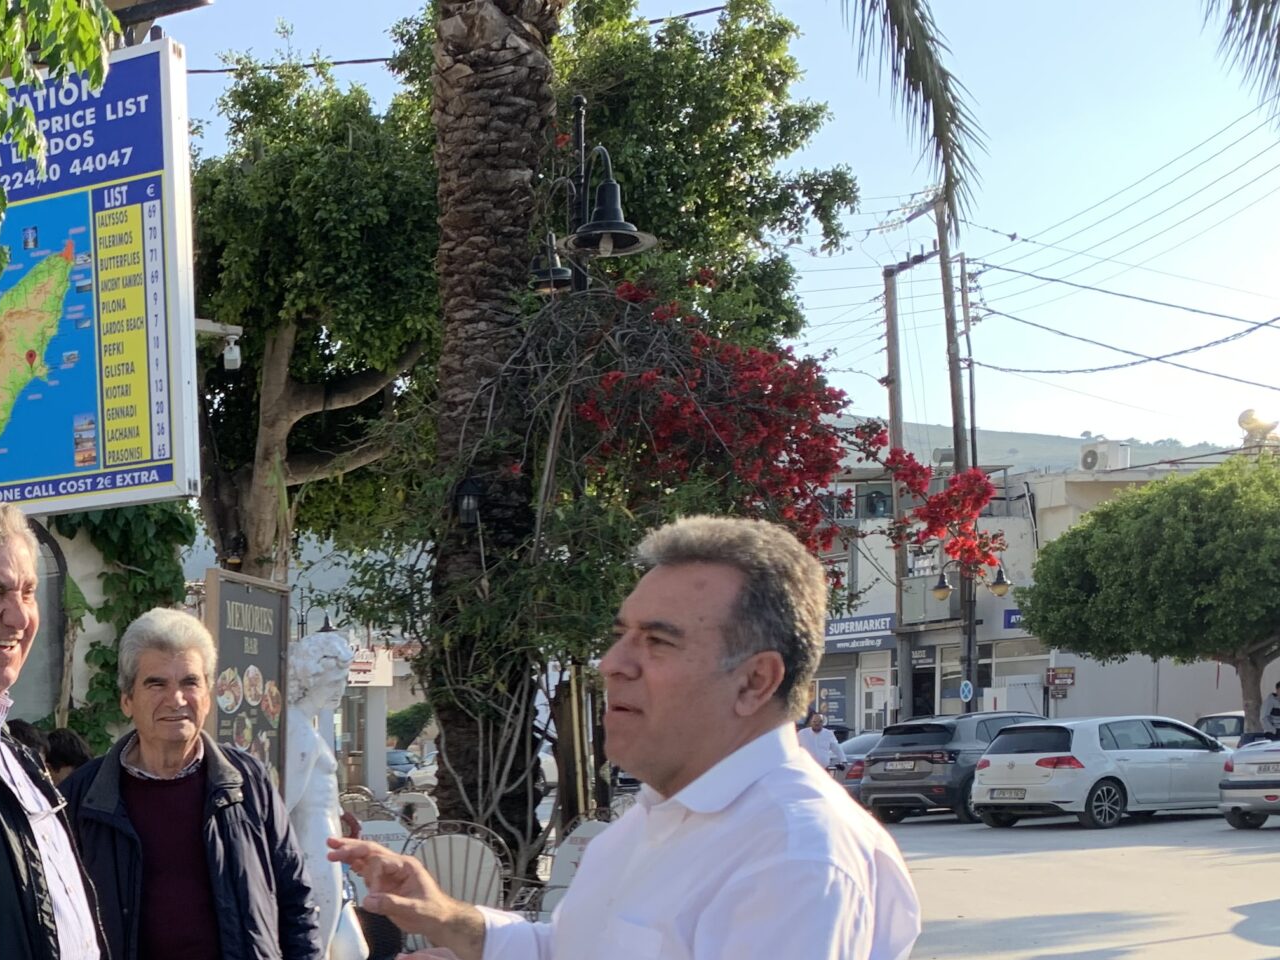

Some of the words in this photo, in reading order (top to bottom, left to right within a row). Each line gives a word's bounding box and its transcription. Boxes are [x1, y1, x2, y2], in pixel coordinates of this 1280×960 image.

[6, 79, 102, 118] TATION
[38, 107, 97, 135] PRICE
[105, 95, 149, 122] LIST
[69, 147, 134, 176] 44047
[103, 185, 129, 209] LIST
[146, 183, 156, 198] €
[97, 210, 129, 228] IALYSSOS
[99, 231, 133, 250] FILERIMOS
[148, 227, 157, 240] 70
[100, 251, 140, 272] BUTTERFLIES
[149, 249, 158, 262] 71
[101, 298, 127, 314] PILONA
[102, 320, 125, 336] LARDOS
[126, 316, 144, 332] BEACH
[104, 361, 135, 378] GLISTRA
[105, 384, 132, 399] KIOTARI
[106, 405, 137, 421] GENNADI
[107, 425, 140, 442] LACHANIA
[107, 447, 143, 463] PRASONISI
[24, 482, 56, 498] CALL
[61, 478, 93, 493] COST
[96, 475, 113, 489] 2€
[116, 469, 160, 487] EXTRA
[225, 600, 274, 636] MEMORIES
[828, 617, 891, 635] SUPERMARKET
[243, 636, 259, 655] BAR
